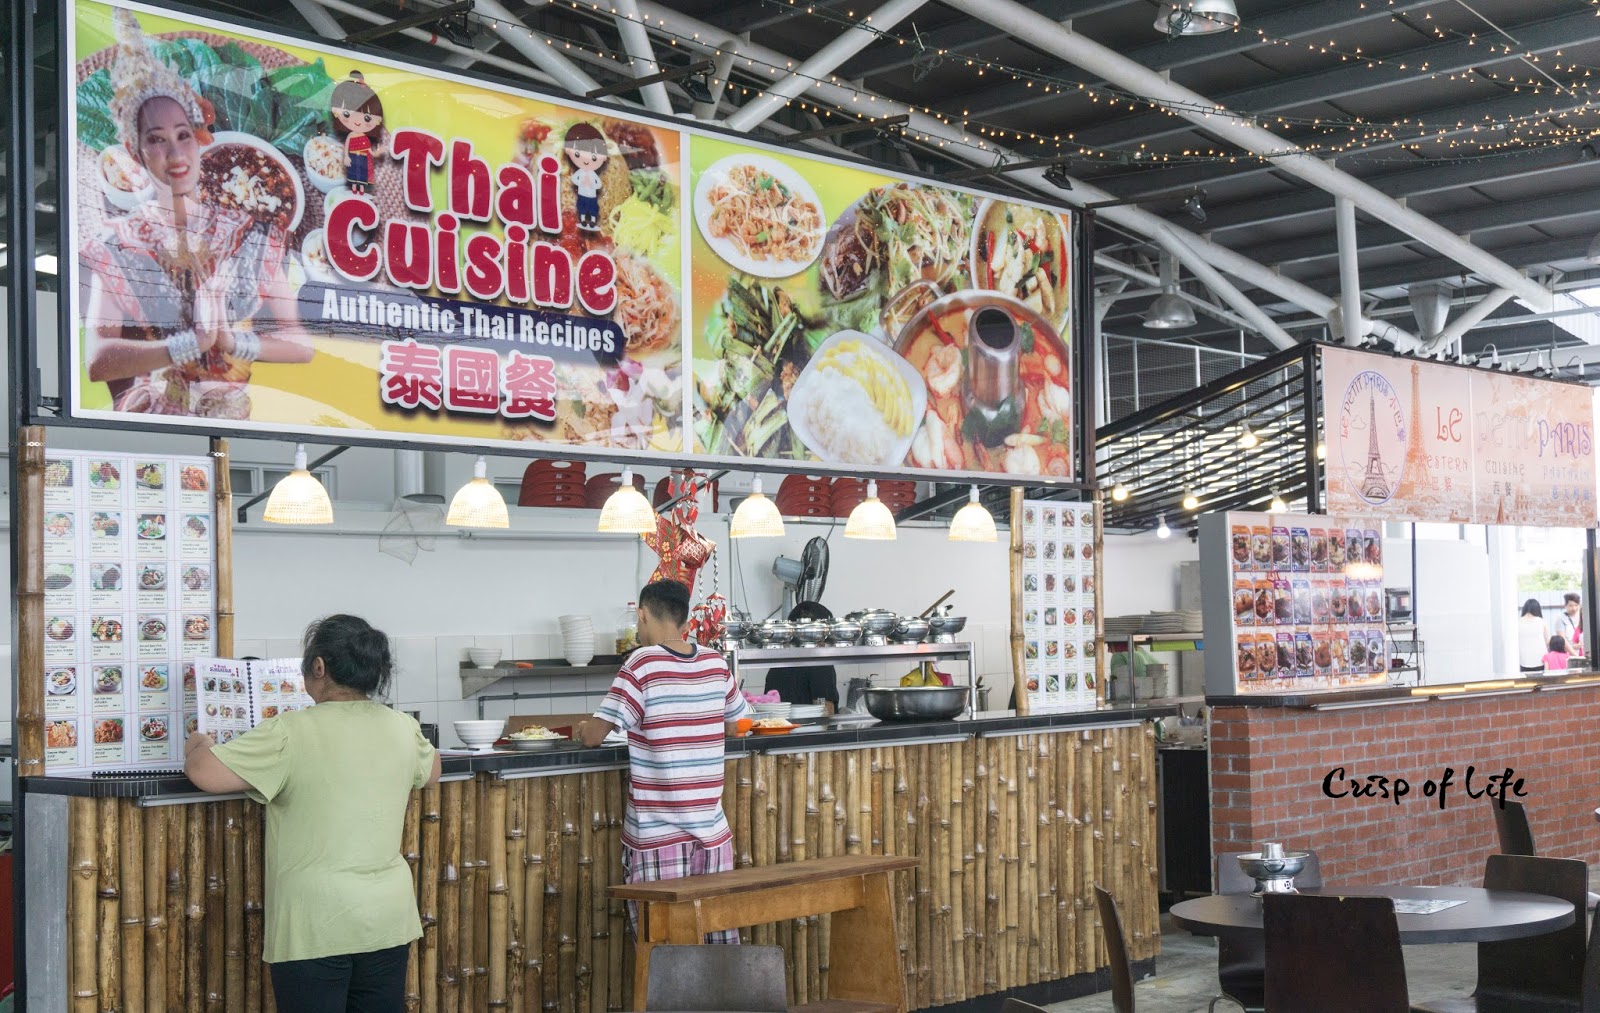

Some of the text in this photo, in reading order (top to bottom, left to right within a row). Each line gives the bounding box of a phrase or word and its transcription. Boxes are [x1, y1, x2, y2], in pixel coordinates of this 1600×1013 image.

[392, 128, 561, 232] Thai
[326, 200, 616, 314] Cuisine
[322, 289, 615, 353] Authentic Thai Recipes
[381, 339, 556, 420] 泰國餐
[1537, 419, 1592, 459] PARIS
